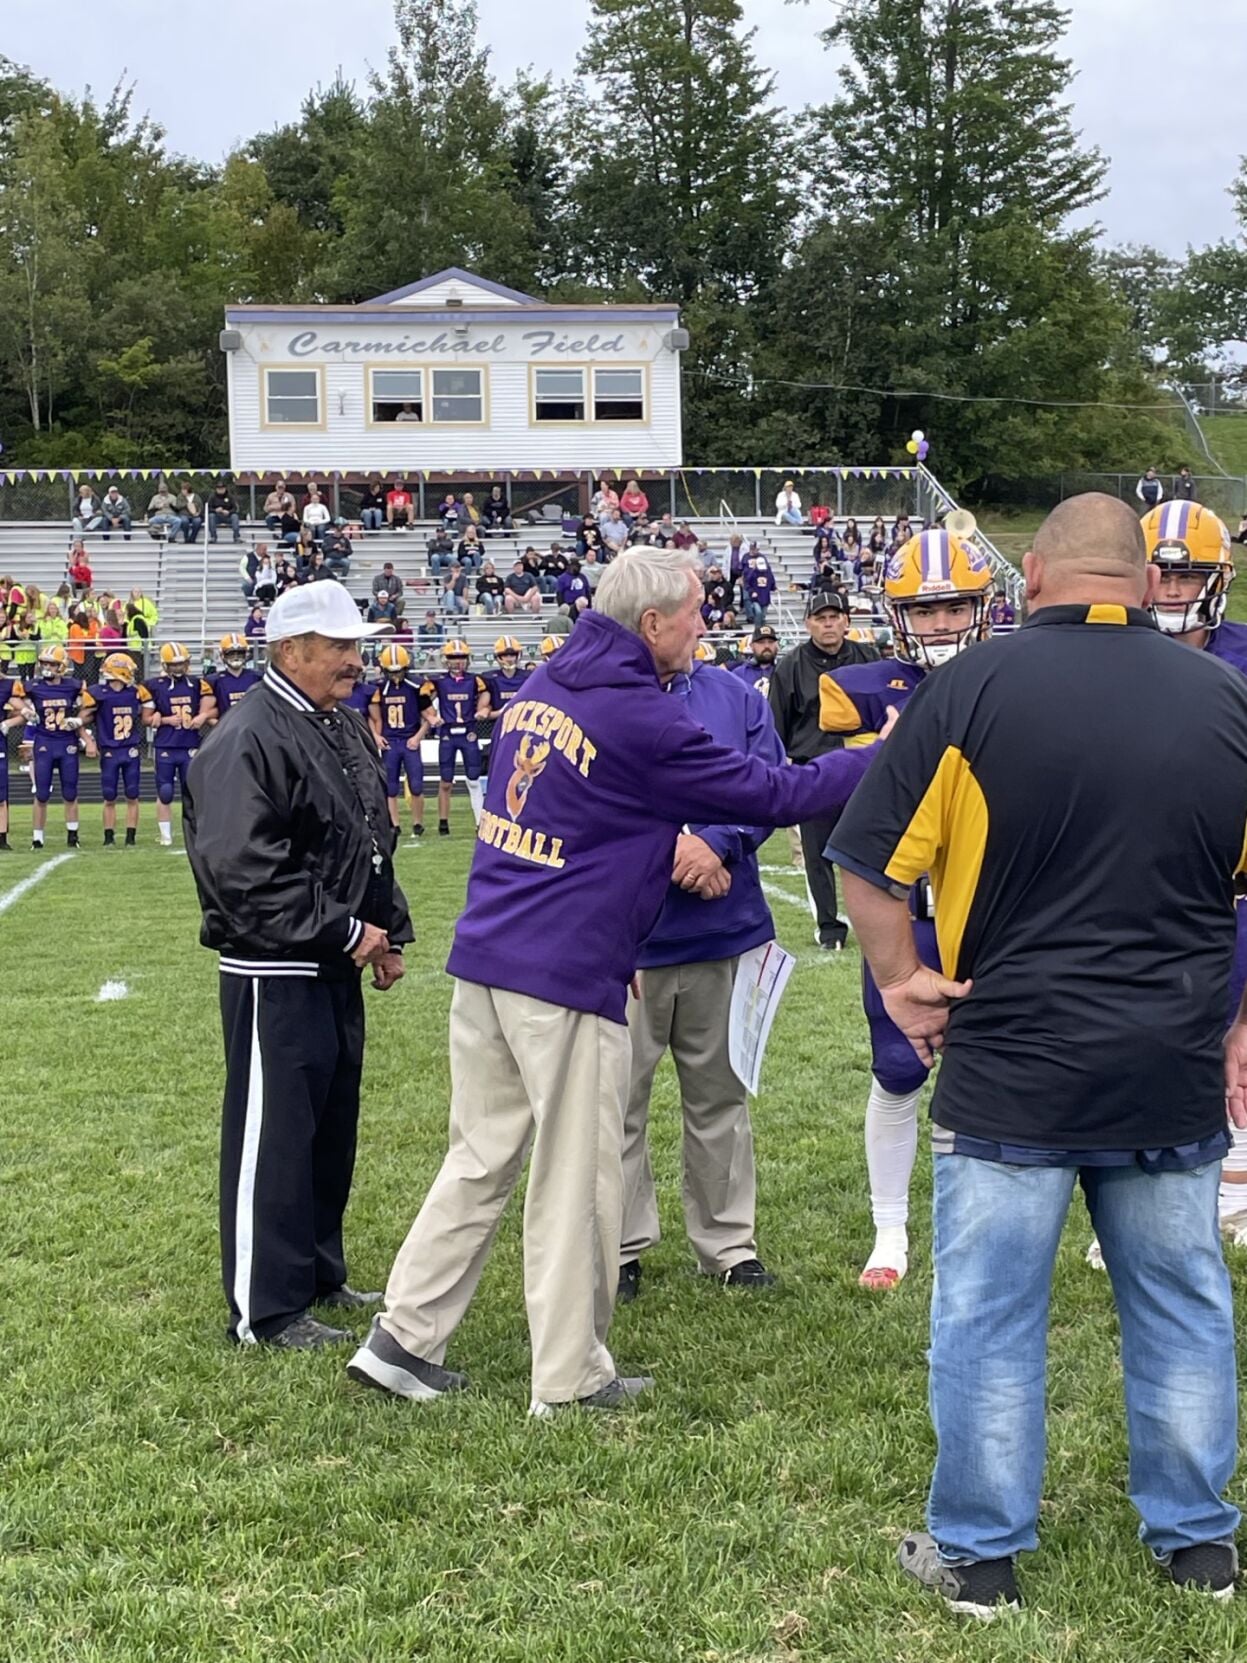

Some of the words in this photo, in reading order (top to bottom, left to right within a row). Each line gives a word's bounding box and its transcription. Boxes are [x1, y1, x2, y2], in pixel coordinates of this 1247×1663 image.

[288, 331, 506, 357] Carmichael
[522, 331, 624, 353] Field
[922, 583, 951, 592] Riddell
[454, 702, 464, 723] 1
[478, 808, 565, 868] FOOTBALL
